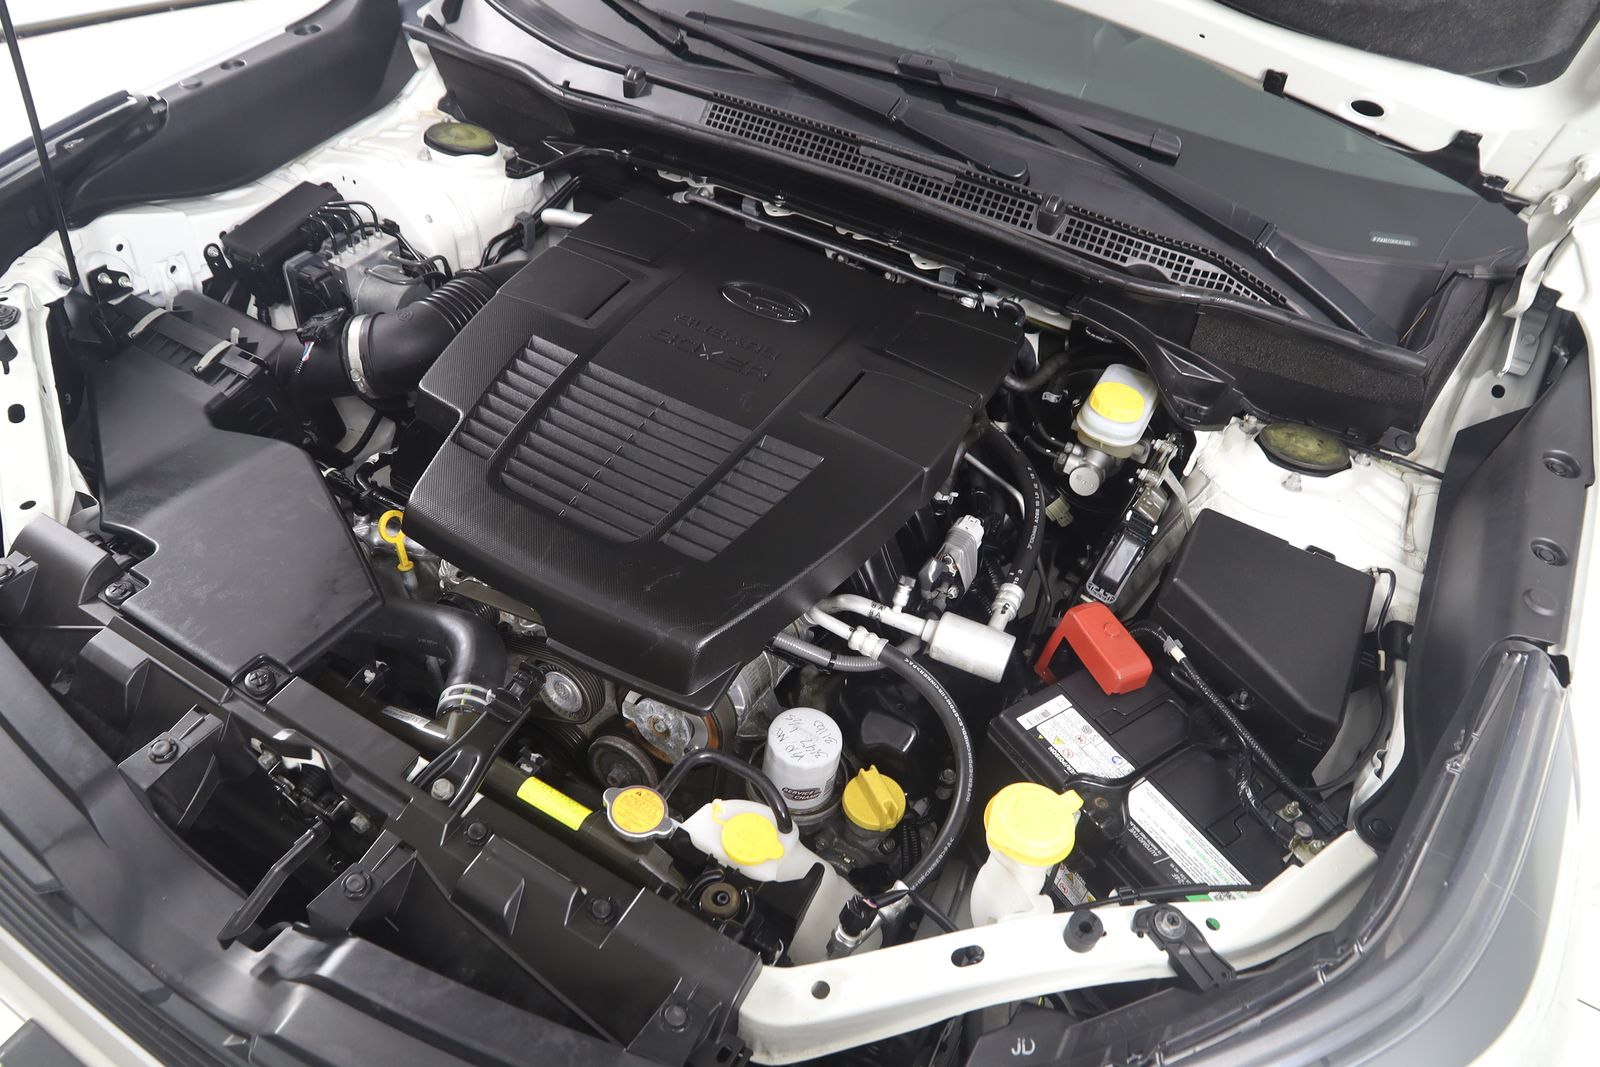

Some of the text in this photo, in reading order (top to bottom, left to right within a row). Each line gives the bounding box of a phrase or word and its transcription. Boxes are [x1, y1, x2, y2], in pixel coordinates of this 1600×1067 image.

[650, 328, 769, 382] BOXER
[674, 313, 783, 361] SUBARU
[1127, 826, 1159, 857] AUTOMOTIVE
[1010, 1037, 1036, 1056] JD
